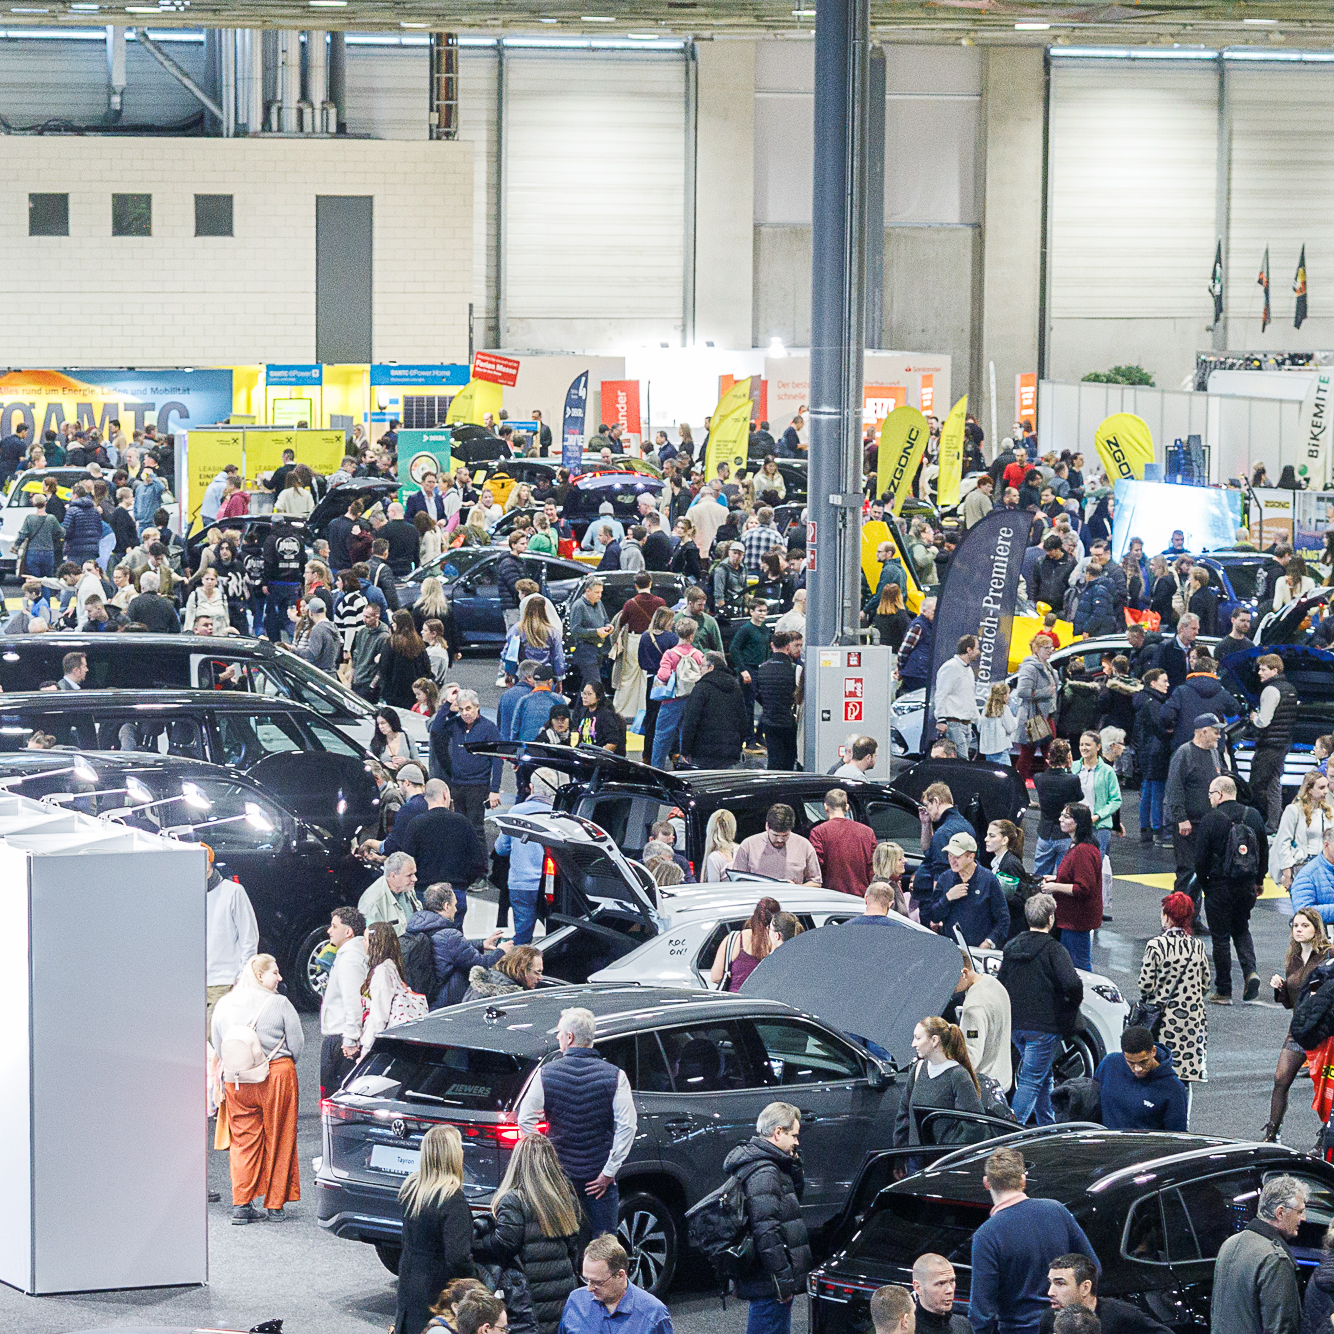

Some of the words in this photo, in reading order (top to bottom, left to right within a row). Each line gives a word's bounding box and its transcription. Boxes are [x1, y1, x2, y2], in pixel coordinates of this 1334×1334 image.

[777, 380, 791, 389] Der
[22, 386, 43, 396] rund
[45, 388, 59, 396] um
[130, 386, 147, 396] und
[777, 391, 806, 401] schnelle
[887, 426, 922, 493] ZGONC
[397, 1156, 415, 1165] Tayron
